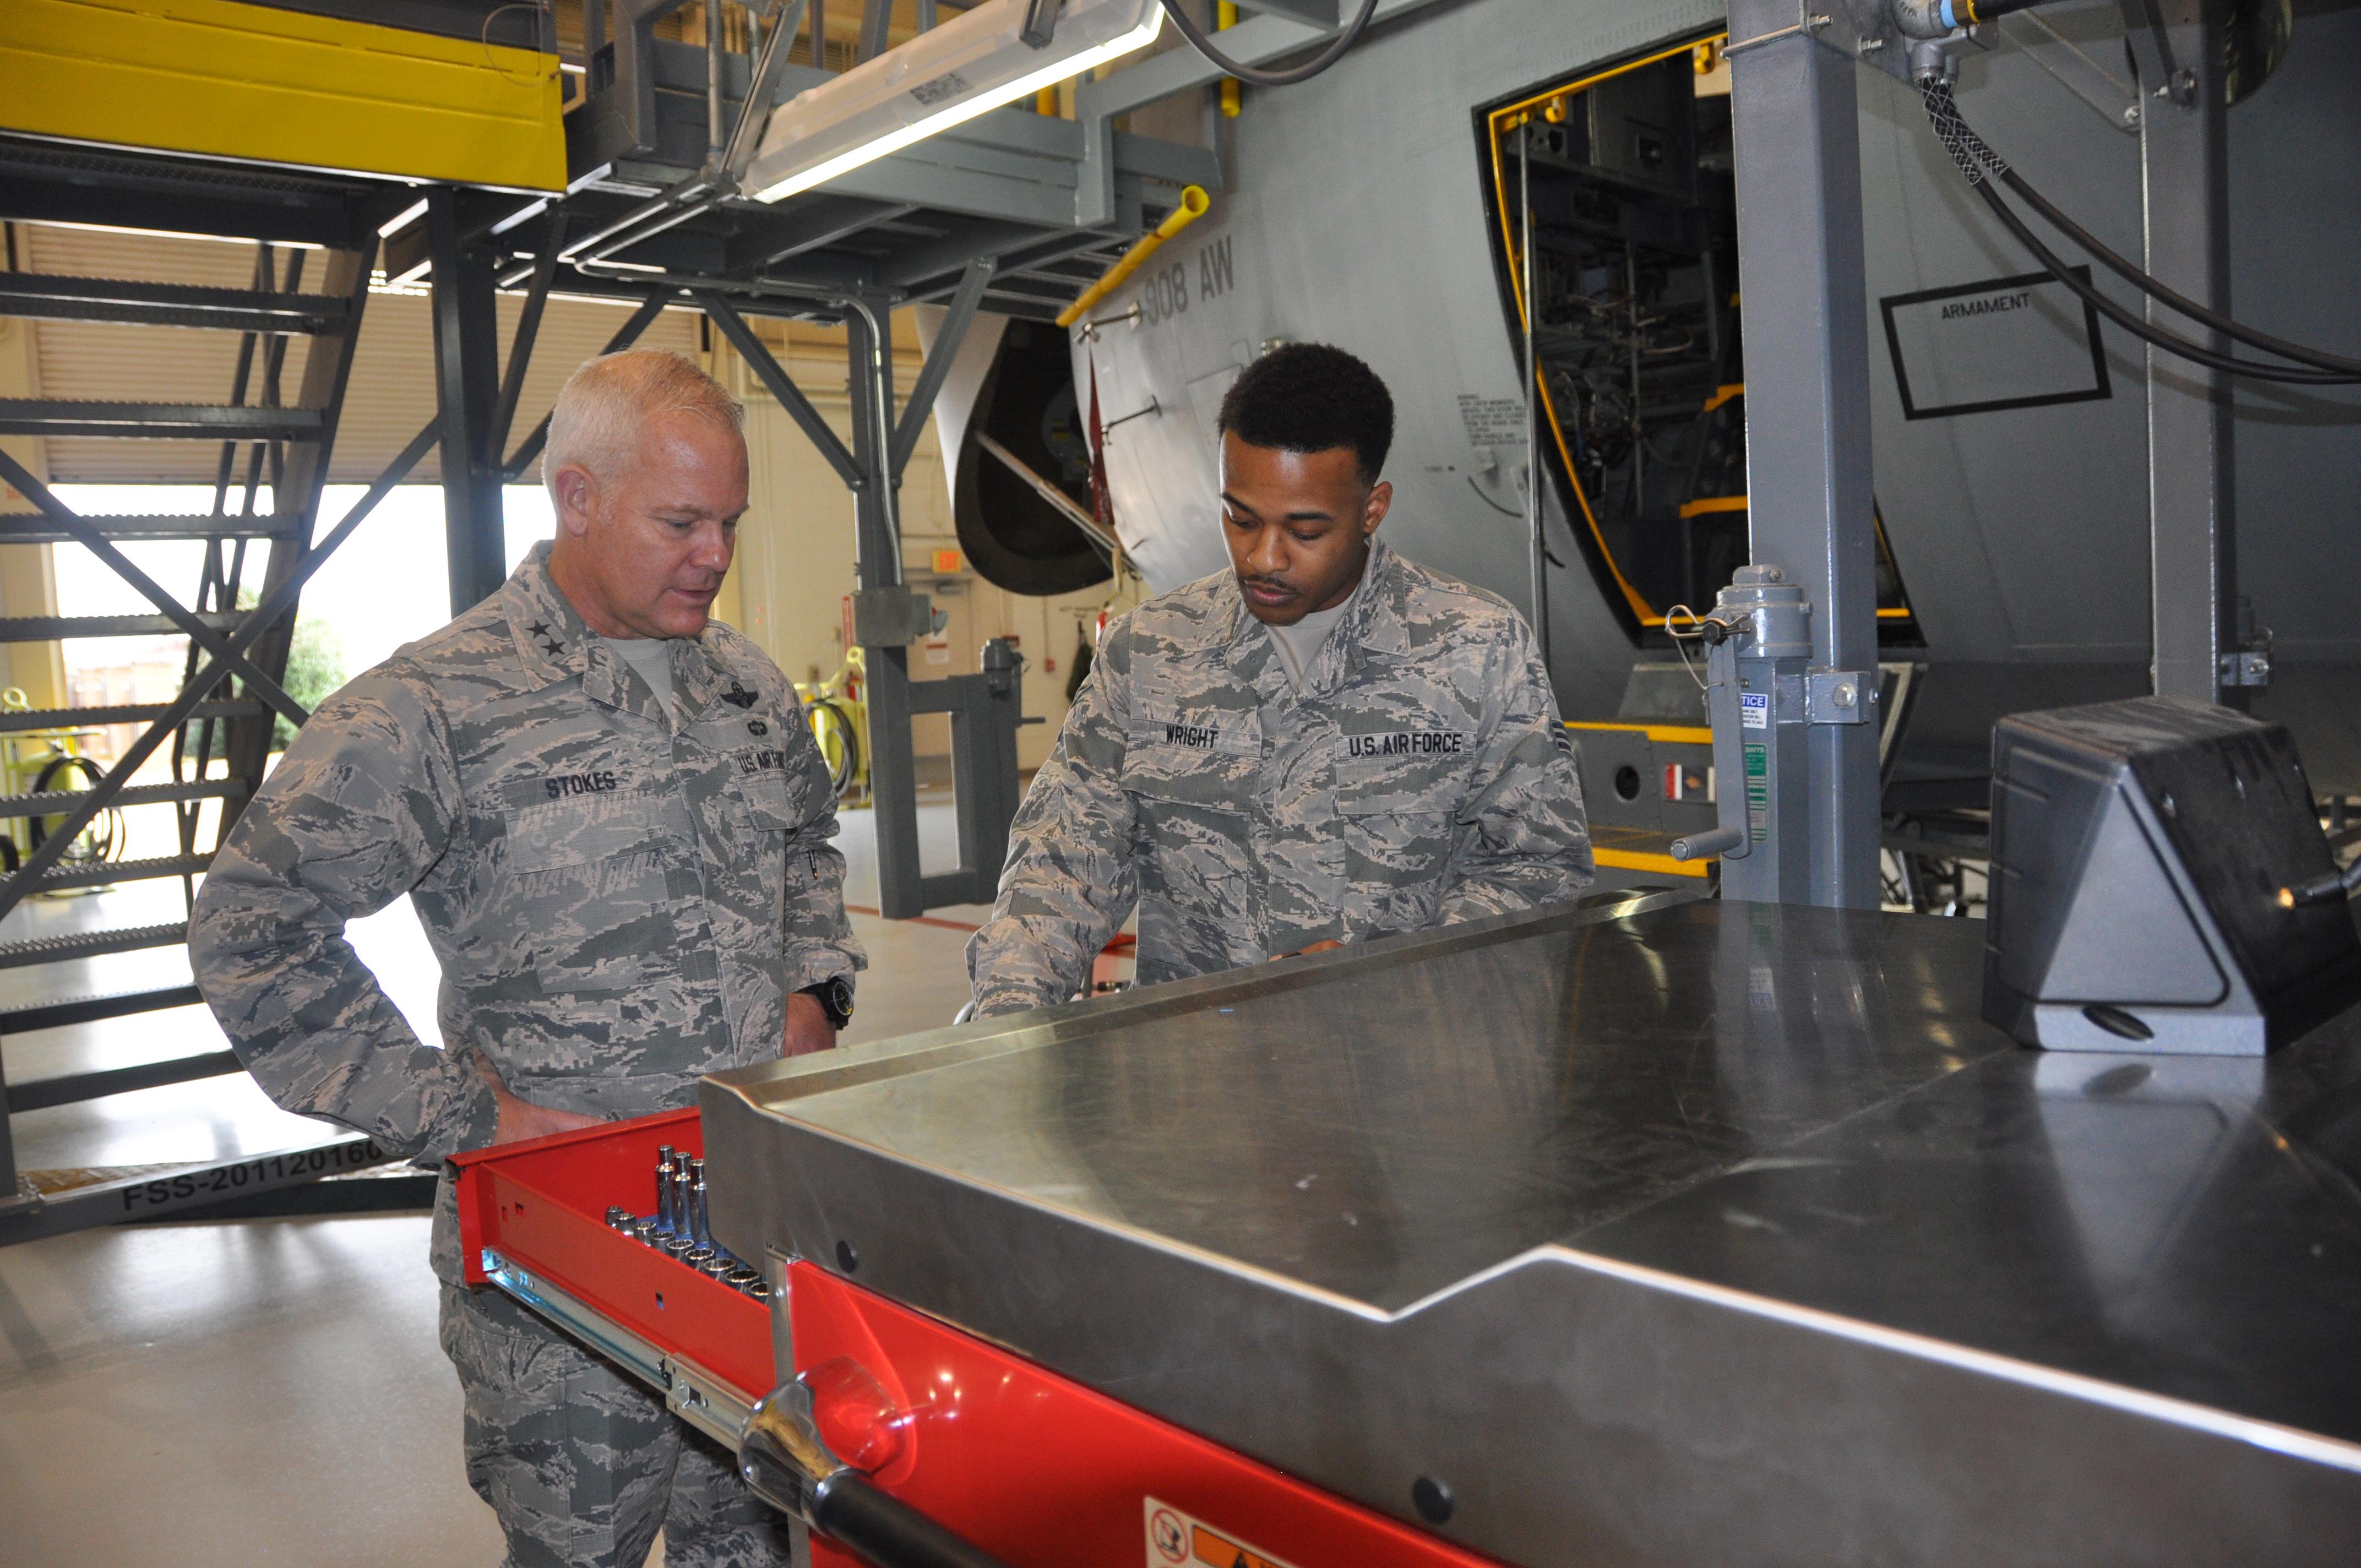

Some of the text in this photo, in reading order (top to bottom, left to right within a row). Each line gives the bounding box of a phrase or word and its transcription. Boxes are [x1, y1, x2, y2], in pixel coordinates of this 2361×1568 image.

[1200, 235, 1234, 302] AW
[1942, 293, 2030, 320] ARMAMENT
[1741, 696, 1765, 706] TICE
[1166, 725, 1218, 749] WRIGHT
[1349, 733, 1462, 756] U.S. AIR FORCE
[545, 771, 617, 798] STOKES
